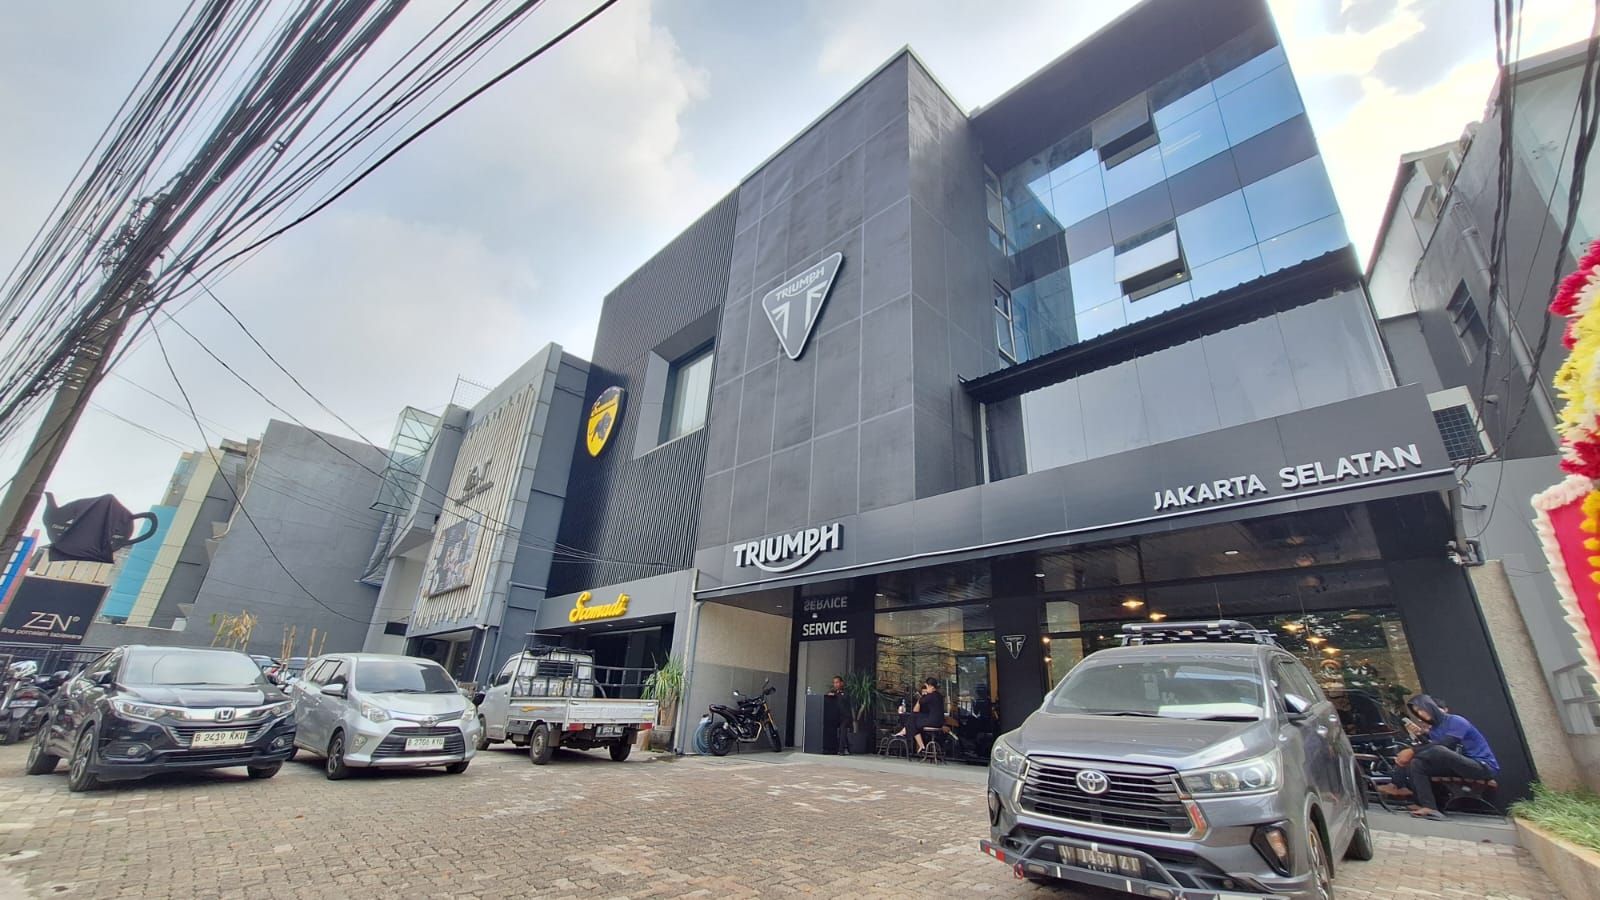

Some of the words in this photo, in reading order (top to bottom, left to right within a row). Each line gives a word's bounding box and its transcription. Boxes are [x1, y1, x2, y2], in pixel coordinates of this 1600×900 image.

[774, 265, 826, 302] TRIUMPH
[1153, 473, 1268, 511] JAKARTA
[1279, 444, 1422, 489] SELATAN
[732, 522, 842, 573] TRIUMPH
[802, 620, 848, 637] SERVICE
[195, 733, 202, 742] B
[1080, 848, 1114, 867] 1454
